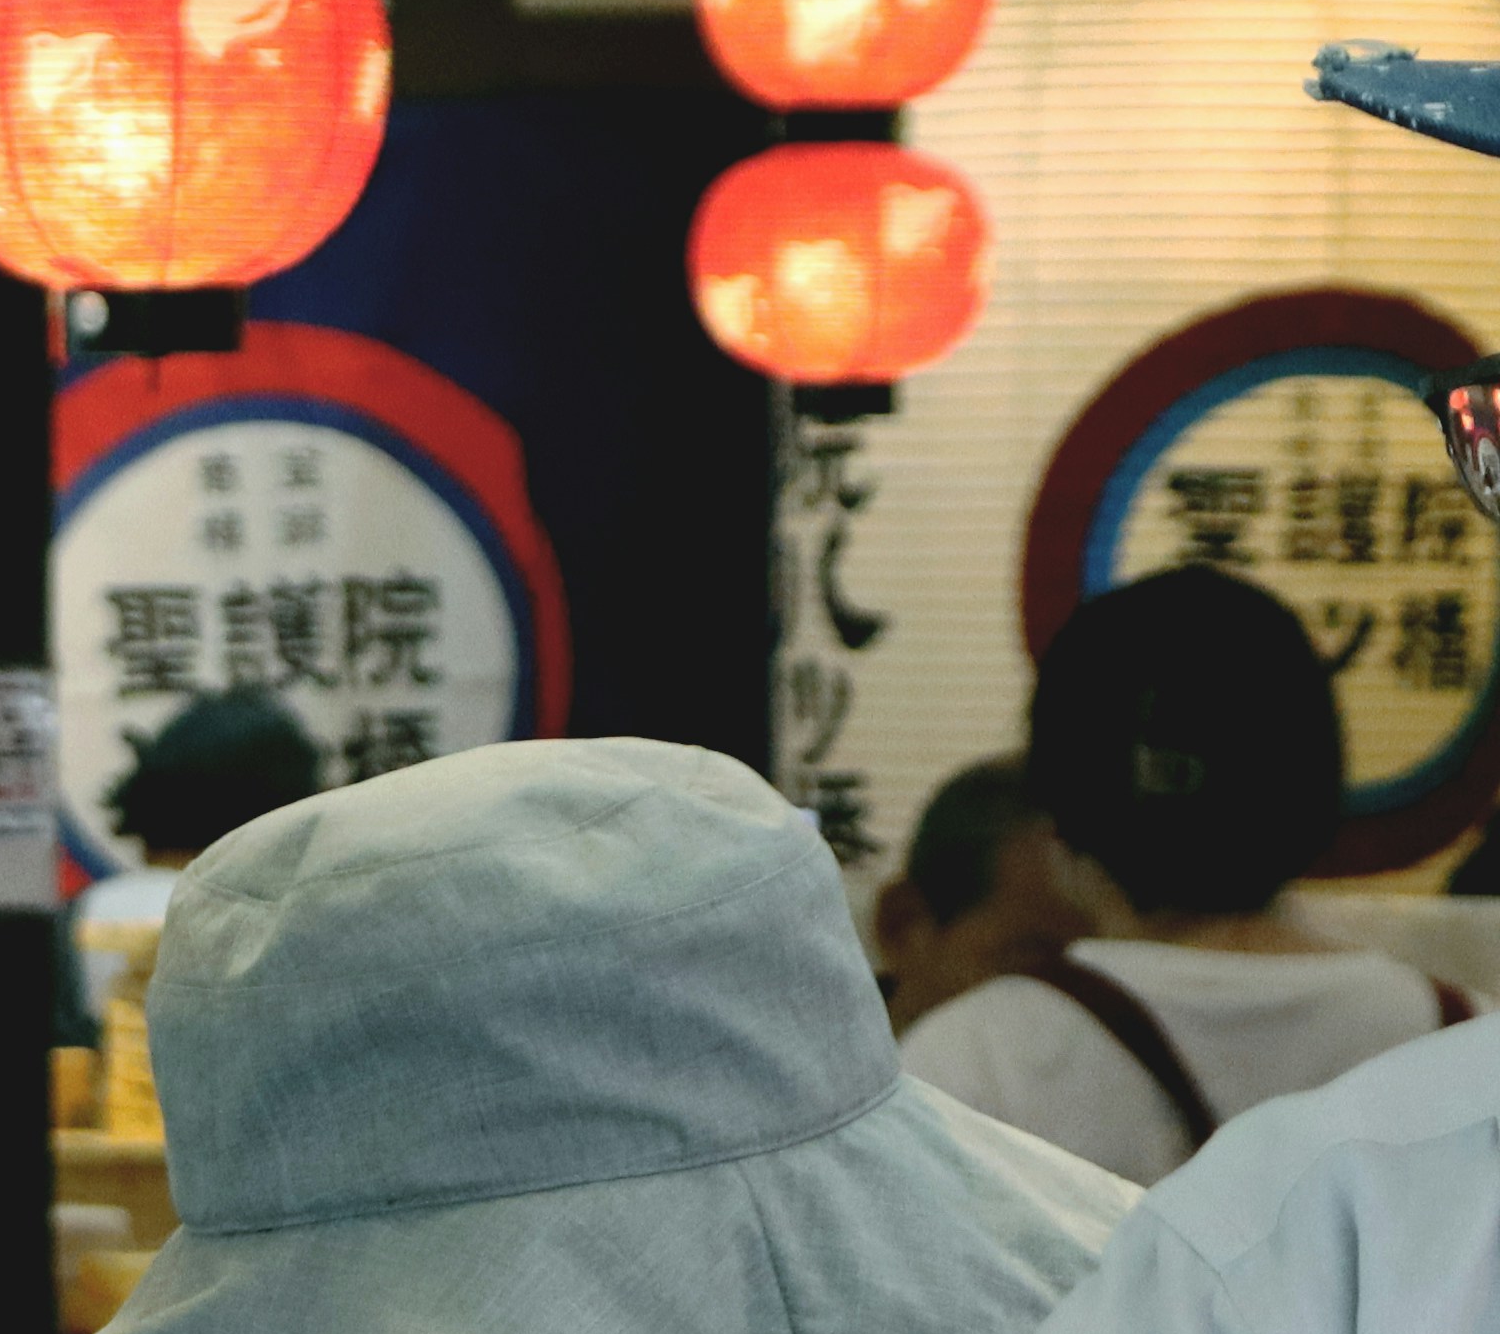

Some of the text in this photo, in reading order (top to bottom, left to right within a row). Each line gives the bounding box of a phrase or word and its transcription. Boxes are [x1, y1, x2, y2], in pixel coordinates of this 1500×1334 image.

[105, 571, 441, 699] 聖護院
[1320, 590, 1472, 691] ツ橋
